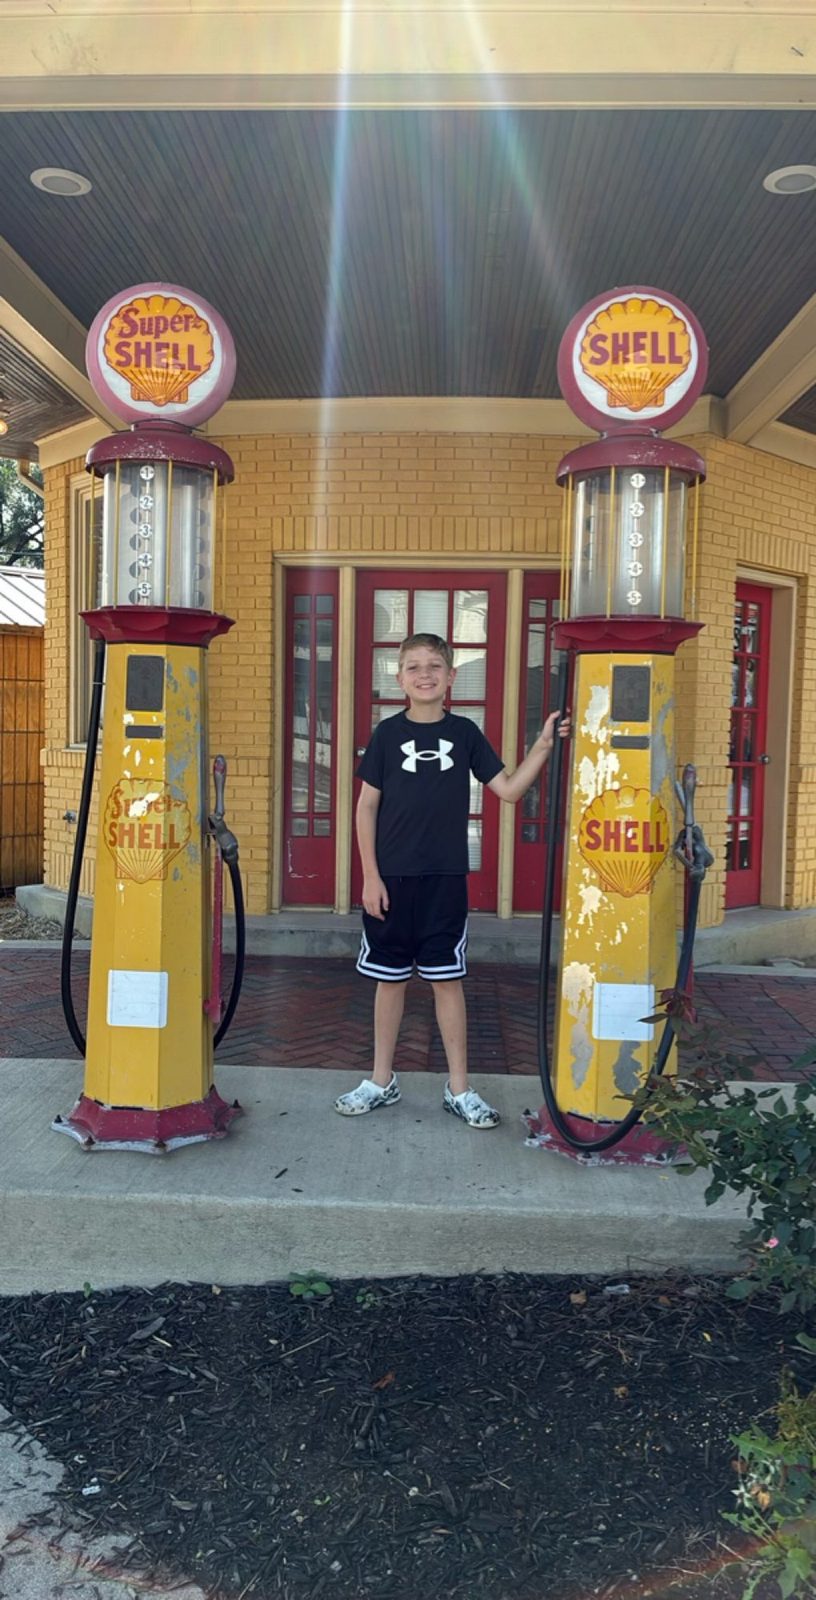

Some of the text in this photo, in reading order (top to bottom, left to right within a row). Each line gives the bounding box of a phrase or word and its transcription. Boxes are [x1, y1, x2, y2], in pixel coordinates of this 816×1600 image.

[114, 341, 202, 371] SHELL
[589, 331, 683, 366] SHELL
[109, 821, 180, 849] SHELL
[585, 819, 664, 853] SHELL
